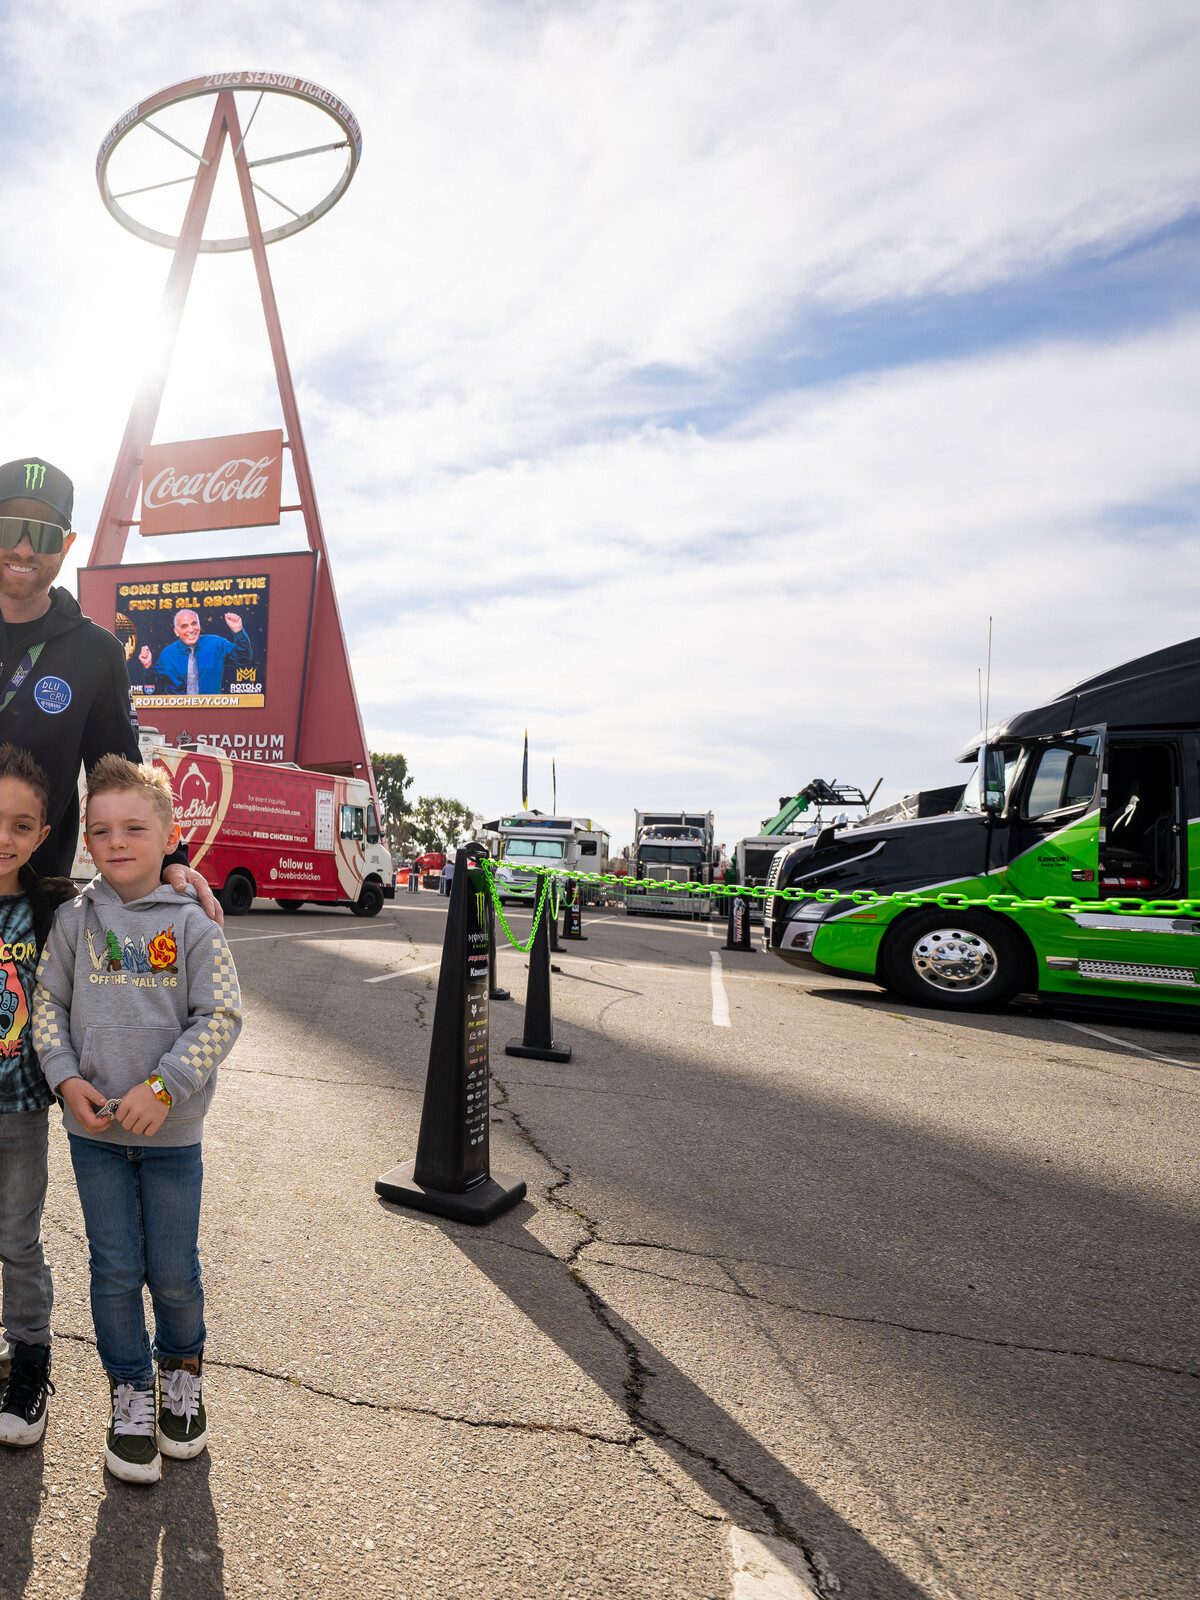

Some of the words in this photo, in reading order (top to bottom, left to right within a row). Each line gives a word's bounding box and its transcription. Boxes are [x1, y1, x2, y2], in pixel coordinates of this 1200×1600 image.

[204, 72, 242, 87] 2023
[246, 72, 300, 89] SEASON
[299, 80, 338, 109] TICKETS
[338, 104, 350, 120] ON
[349, 114, 362, 139] SALE
[118, 106, 138, 131] NOW
[144, 456, 278, 509] Coca-Cola
[119, 583, 159, 596] COME
[162, 582, 188, 594] SEE
[191, 578, 233, 592] WHAT
[236, 577, 266, 589] THE
[129, 599, 156, 611] FUN
[159, 598, 173, 610] IS
[175, 597, 201, 609] ALL
[203, 593, 258, 607] ABOUT!
[230, 683, 262, 691] ROTOLO
[136, 697, 239, 706] ROTOLOCHEVY.COM
[196, 734, 284, 748] STADIUM
[225, 749, 283, 760] AHEIM
[184, 798, 217, 818] Bird
[233, 802, 301, 817] catering@lovebirdchicken.com
[231, 829, 252, 838] ORIGINAL
[253, 831, 270, 839] FRIED
[270, 833, 294, 841] CHICKEN
[294, 835, 309, 843] TRUCK
[279, 857, 303, 869] follow
[304, 861, 313, 870] us
[1038, 855, 1069, 863] Kawasaki
[279, 870, 321, 880] lovebirdchicken
[88, 973, 110, 985] OFF
[111, 974, 128, 985] THE
[130, 976, 158, 988] WALL
